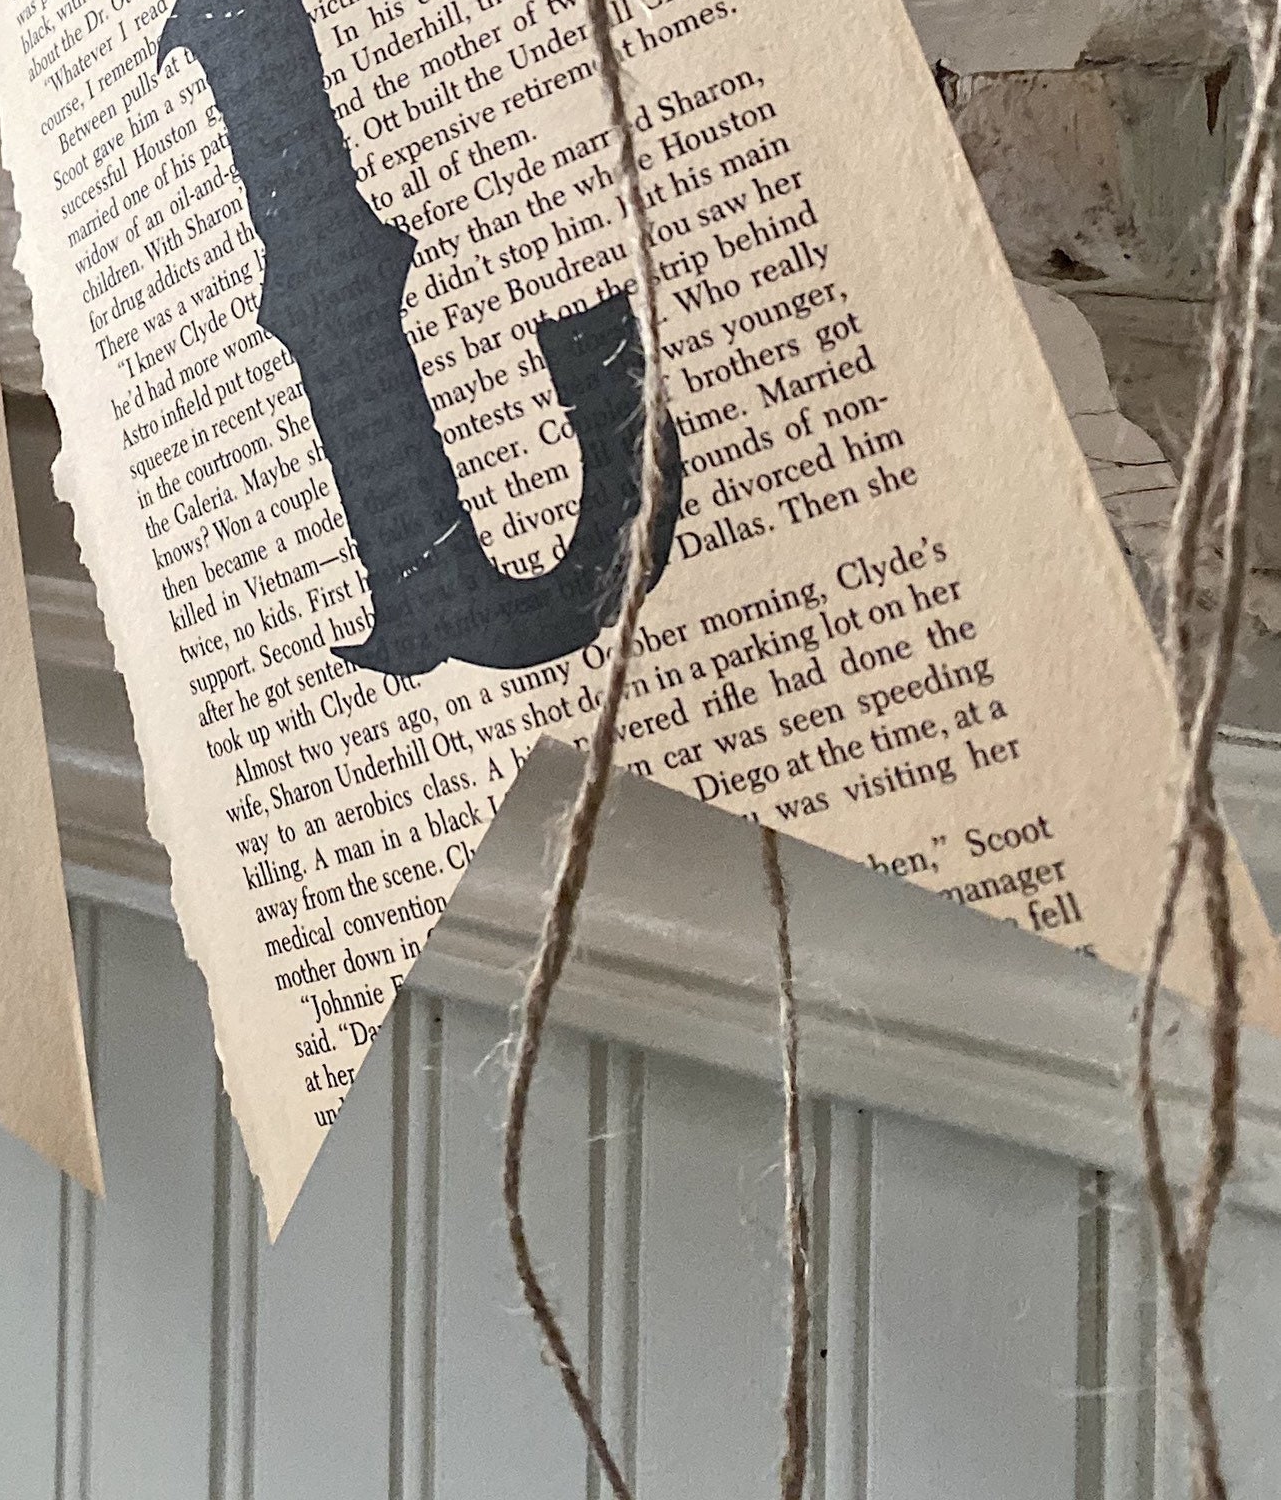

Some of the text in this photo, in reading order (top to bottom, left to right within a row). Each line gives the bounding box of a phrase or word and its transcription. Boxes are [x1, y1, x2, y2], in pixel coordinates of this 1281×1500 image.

[657, 102, 777, 161] Houston
[712, 197, 818, 259] behind
[660, 282, 847, 360] was younger,
[671, 240, 828, 313] Who really
[675, 343, 876, 437] time. Married
[680, 312, 862, 393] brothers got
[674, 464, 917, 560] Dallas. Then she
[711, 428, 904, 507] divorced him
[151, 476, 329, 570] knows? Won a couple
[654, 580, 960, 690] in a parking lot on her
[699, 581, 827, 635] morning,
[663, 657, 994, 769] car was seen speeding
[701, 618, 976, 718] rifle had done the
[225, 696, 573, 823] wife, Sharon Underhill Ott, was shot
[235, 660, 570, 786] Almost two years ago, on a sunny
[694, 699, 1008, 804] Diego at the time, at a
[774, 738, 1019, 820] was visiting her
[241, 799, 482, 890] killing. A man in a black
[964, 814, 1054, 857] Scoot
